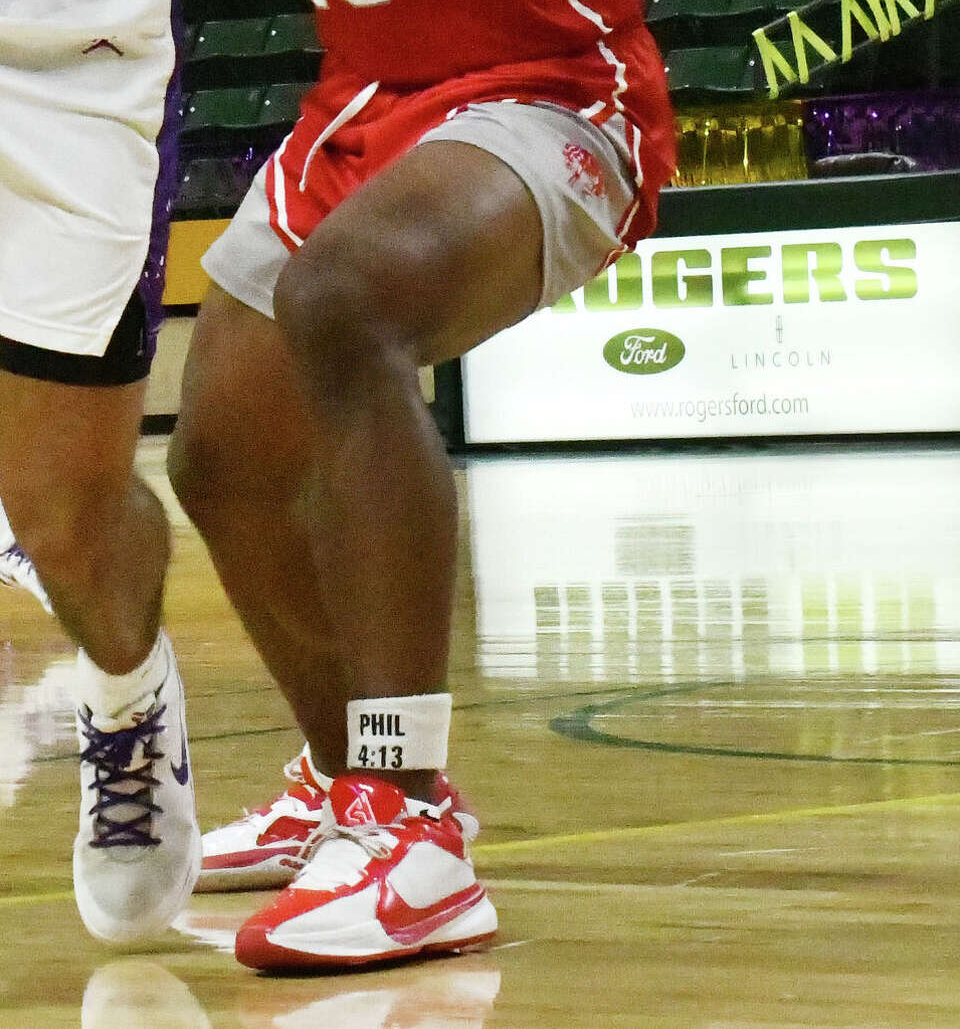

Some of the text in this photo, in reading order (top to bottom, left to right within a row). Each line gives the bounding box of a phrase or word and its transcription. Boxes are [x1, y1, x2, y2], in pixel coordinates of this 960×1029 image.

[552, 238, 919, 314] OGERS
[619, 334, 668, 365] Ford
[731, 350, 831, 370] LINCOLN
[630, 393, 809, 423] www.rogersford.com
[359, 713, 406, 737] PHIL
[357, 744, 404, 769] 4:13
